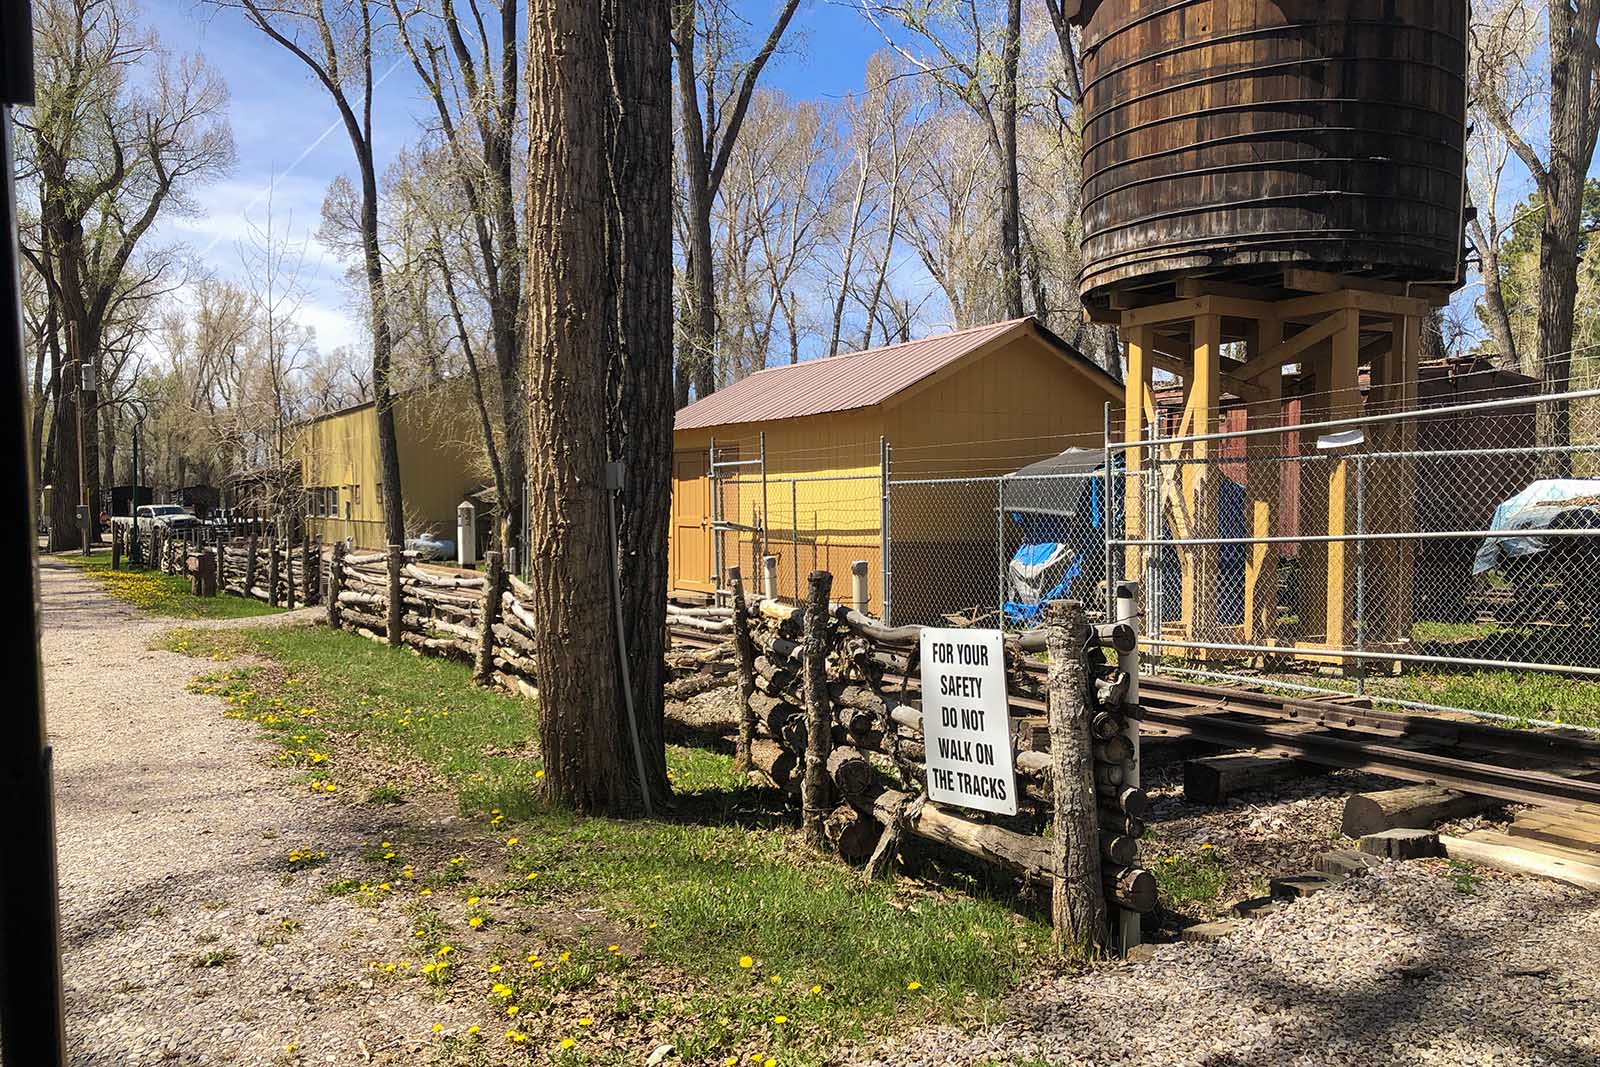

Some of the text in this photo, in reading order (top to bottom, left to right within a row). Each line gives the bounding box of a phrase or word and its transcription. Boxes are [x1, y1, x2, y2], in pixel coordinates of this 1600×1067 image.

[932, 643, 989, 666] FOR YOUR
[940, 675, 982, 699] SAFETY
[942, 707, 985, 732] DO NOT
[938, 737, 994, 766] WALK ON
[932, 768, 1007, 800] THE TRACKS
